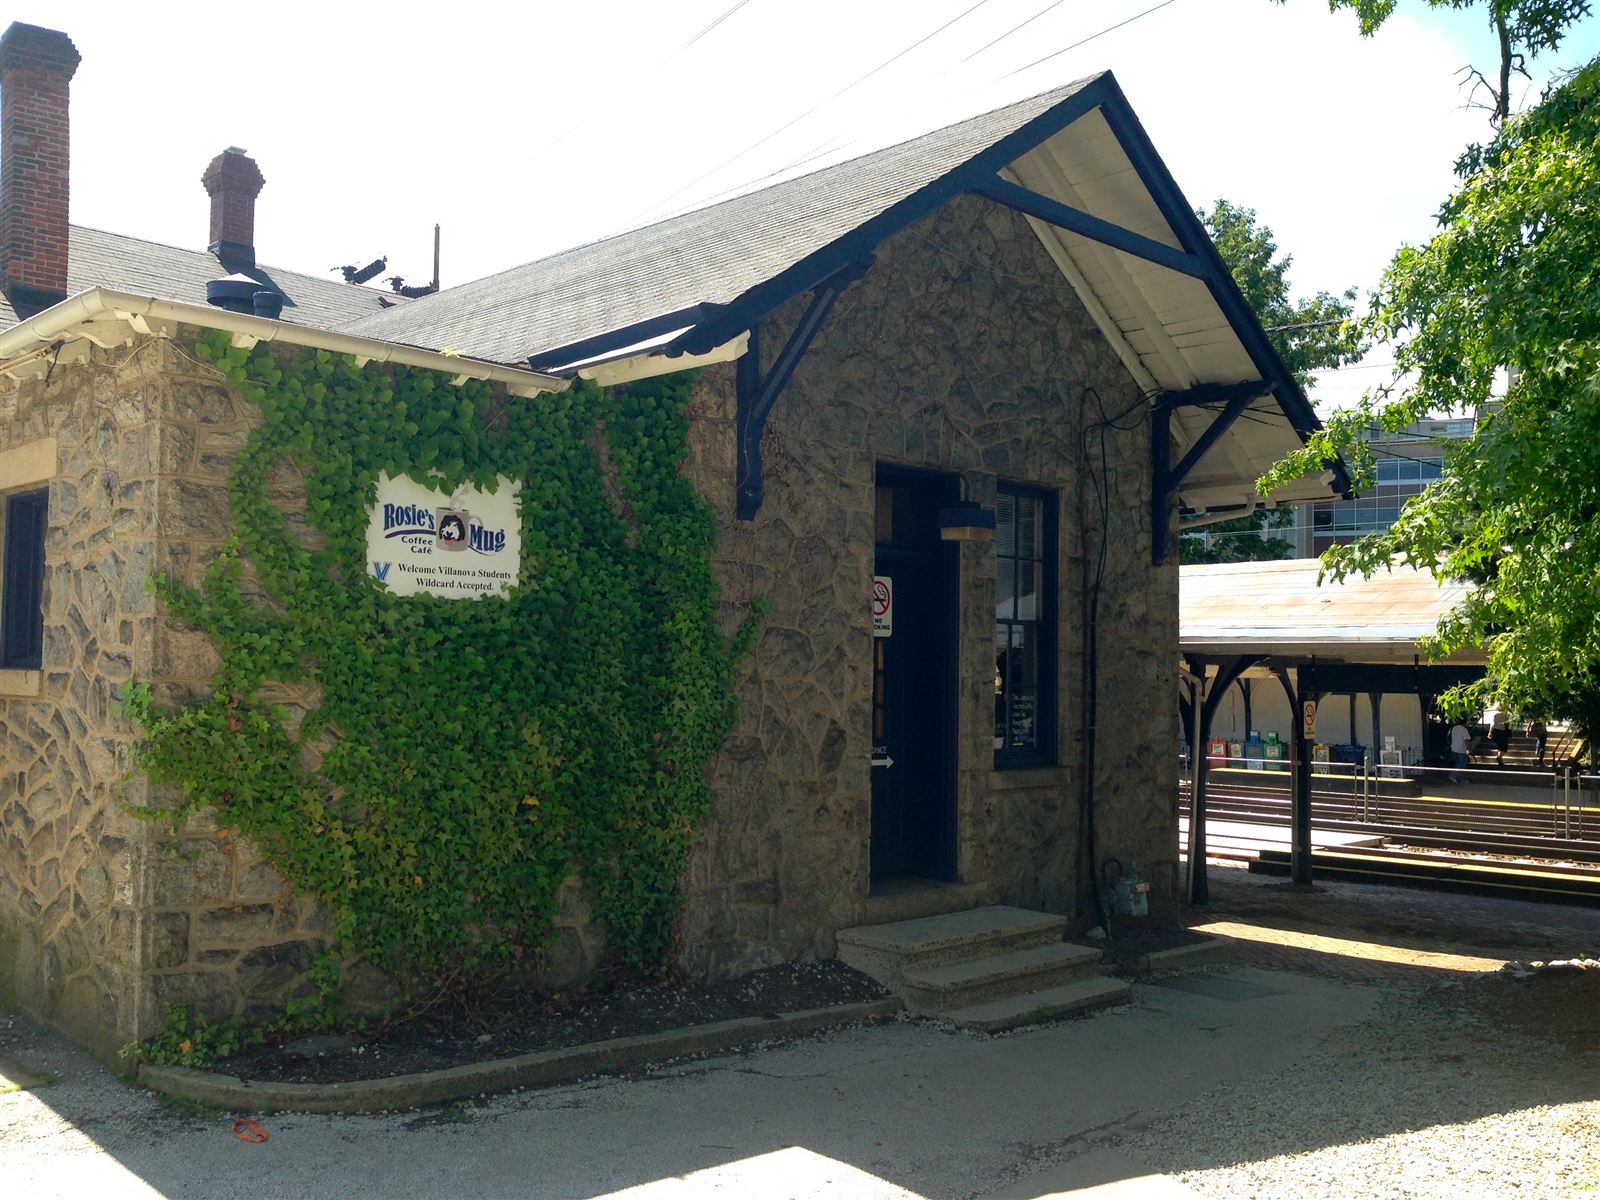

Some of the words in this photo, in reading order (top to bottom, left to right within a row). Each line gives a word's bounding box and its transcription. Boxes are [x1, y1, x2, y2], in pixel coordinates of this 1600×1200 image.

[383, 503, 435, 530] Rosie's
[470, 524, 505, 552] Mug
[401, 536, 433, 546] Coffee
[411, 545, 432, 555] Café
[398, 563, 436, 575] Welcome
[438, 566, 476, 578] Villanova
[478, 569, 511, 580] Students
[416, 577, 455, 589] Wildcard
[456, 581, 494, 592] Accepted.
